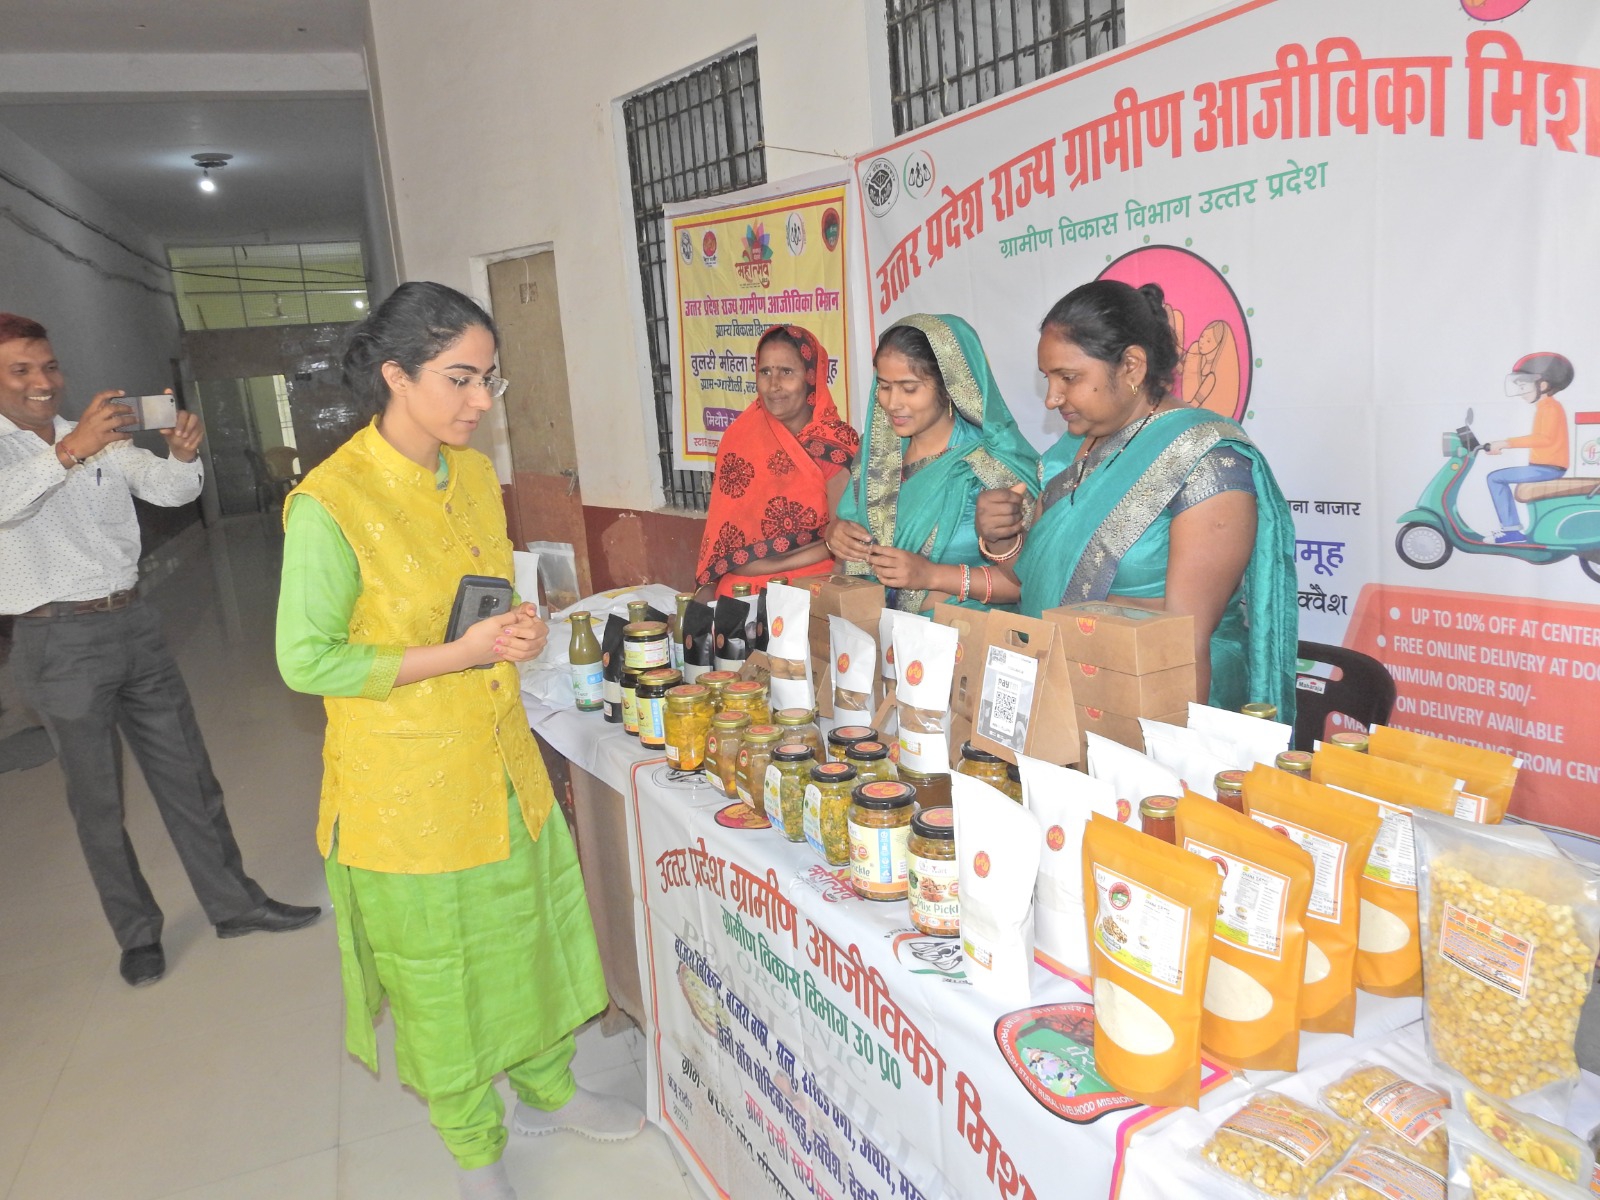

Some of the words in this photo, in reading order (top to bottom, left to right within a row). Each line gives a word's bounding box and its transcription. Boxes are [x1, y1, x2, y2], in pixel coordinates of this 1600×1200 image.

[876, 224, 922, 315] उत्तर
[925, 177, 985, 269] प्रदेश
[989, 149, 1057, 223] राज्य
[1062, 87, 1186, 192] ग्रामीण
[1191, 36, 1453, 154] आजीविका
[999, 224, 1054, 259] ग्रामीण
[1058, 215, 1119, 247] विकास
[1125, 194, 1191, 234] विभाग
[1198, 178, 1257, 215] उत्तर
[1267, 157, 1330, 204] प्रदेश
[685, 300, 702, 316] उत्तर
[703, 295, 720, 316] प्रदेश
[721, 299, 738, 315] राज्य
[739, 292, 766, 315] ग्रामीण
[768, 289, 814, 314] आजीविका
[815, 287, 840, 312] मिशन
[732, 319, 754, 337] विकास
[691, 349, 716, 376] तुलसी
[719, 349, 748, 373] महिला
[1314, 501, 1361, 516] बाजार
[1294, 539, 1346, 577] मूह
[1297, 583, 1348, 616] क्वैश
[1411, 607, 1430, 625] UP
[1433, 609, 1452, 628] TO
[1455, 612, 1485, 632] 10%
[1488, 615, 1517, 636] OFF
[1520, 619, 1539, 639] AT
[1541, 622, 1600, 647] CENTER
[1393, 635, 1424, 655] FREE
[1426, 640, 1477, 663] ONLINE
[1480, 646, 1546, 674] DELIVERY
[1549, 657, 1569, 677] AT
[1572, 660, 1600, 682] DO
[1298, 681, 1323, 692] Maharaja
[1446, 673, 1496, 697] ORDER
[1499, 681, 1537, 707] 500/-
[1396, 695, 1417, 714] ON
[1420, 700, 1485, 727] DELIVERY
[1486, 712, 1565, 744] AVAILABLE
[1566, 761, 1600, 784] CEN
[916, 900, 931, 912] Mix
[933, 903, 959, 915] Pickl
[656, 848, 690, 893] उत्तर
[688, 837, 726, 900] प्रदेश
[730, 862, 798, 949] ग्रामीण
[805, 918, 947, 1106] आजीविका
[720, 904, 757, 961] ग्रामीण
[757, 931, 801, 1001] विकास
[804, 969, 849, 1044] विभाग
[726, 988, 750, 1032] बाजरा
[737, 950, 868, 1085] ORGANIC
[1001, 1028, 1019, 1068] PRADESH
[1018, 1066, 1037, 1092] STATE
[1038, 1088, 1060, 1110] RURAL
[745, 1090, 764, 1133] ग्राम
